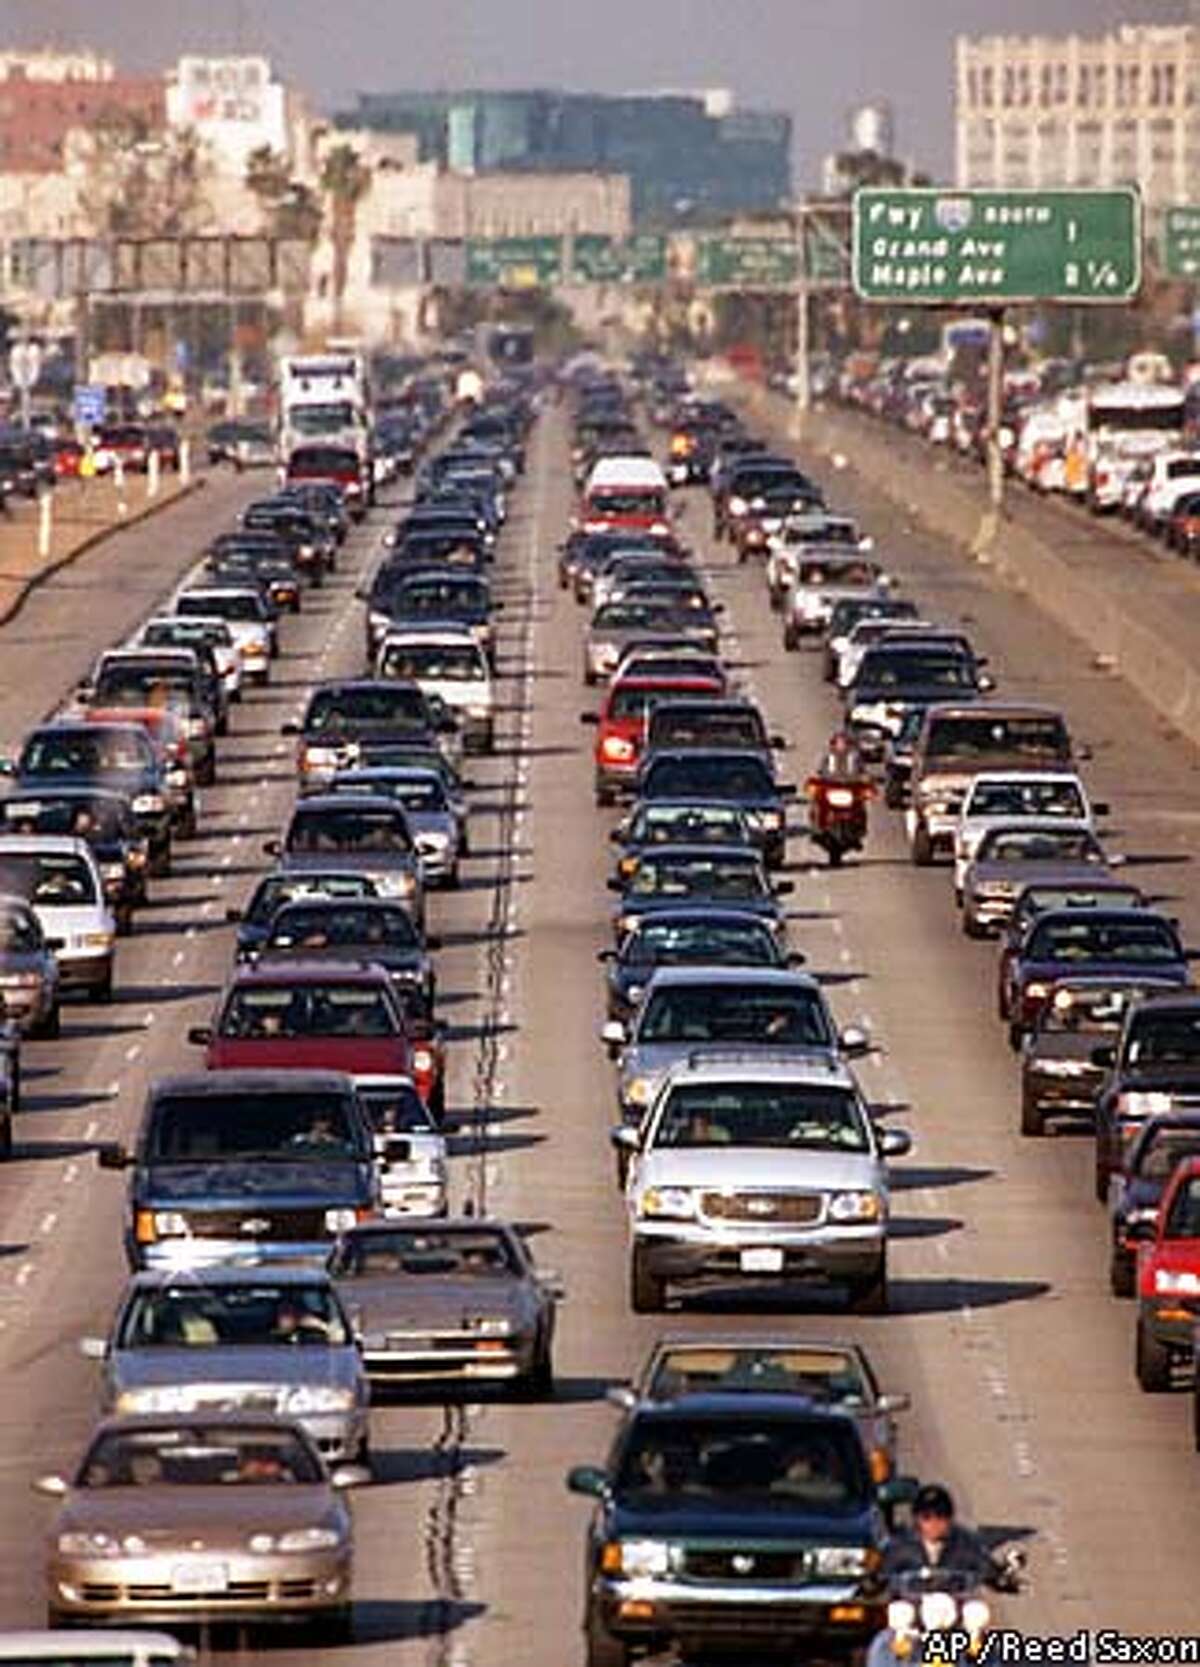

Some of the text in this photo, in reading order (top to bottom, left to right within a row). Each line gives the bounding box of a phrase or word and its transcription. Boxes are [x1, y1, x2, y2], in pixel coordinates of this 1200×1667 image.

[870, 202, 922, 232] Fwy
[873, 238, 1004, 258] Grand Ave
[873, 263, 946, 290] Maple
[958, 264, 1003, 285] Ave
